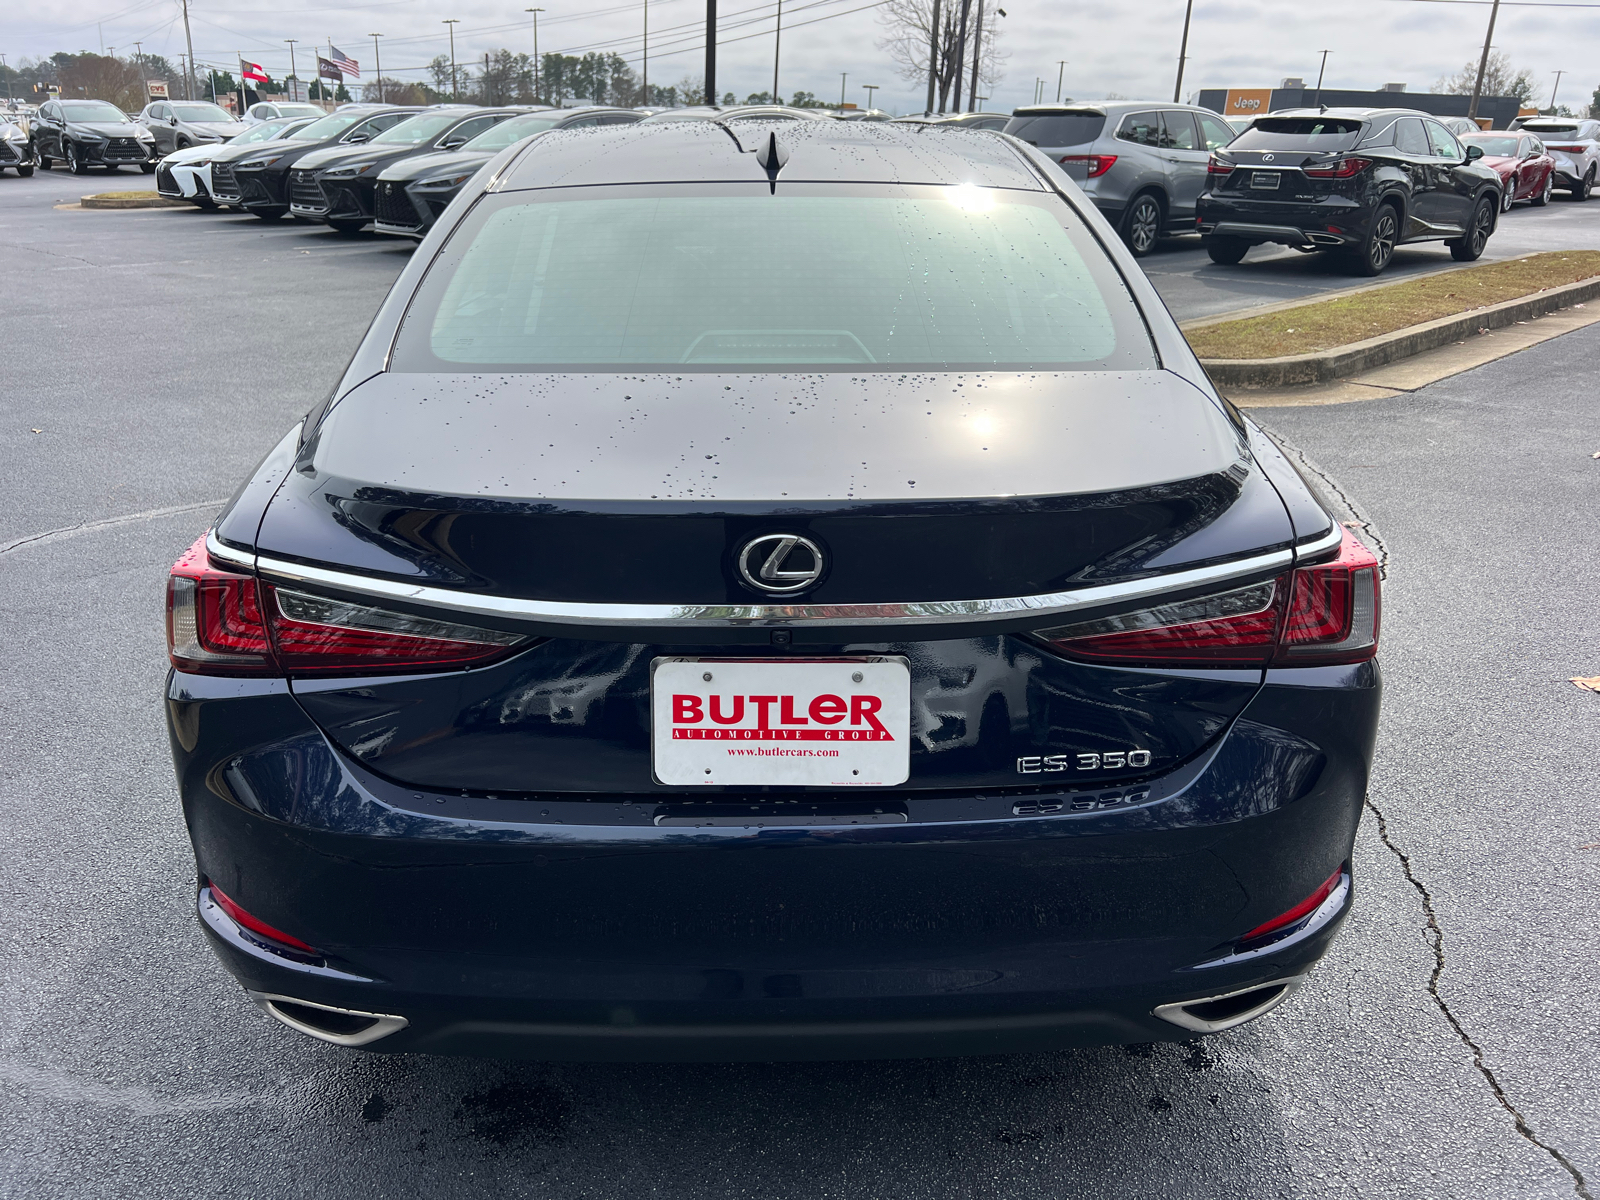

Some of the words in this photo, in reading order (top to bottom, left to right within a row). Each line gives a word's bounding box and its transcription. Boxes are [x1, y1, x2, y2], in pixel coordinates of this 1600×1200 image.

[1234, 96, 1261, 111] Jeep
[673, 730, 802, 739] AUTOMOTIVE
[824, 731, 886, 740] GROUP
[727, 747, 839, 757] www.butlercars.com
[1016, 755, 1069, 774] ES
[1076, 750, 1151, 771] 350
